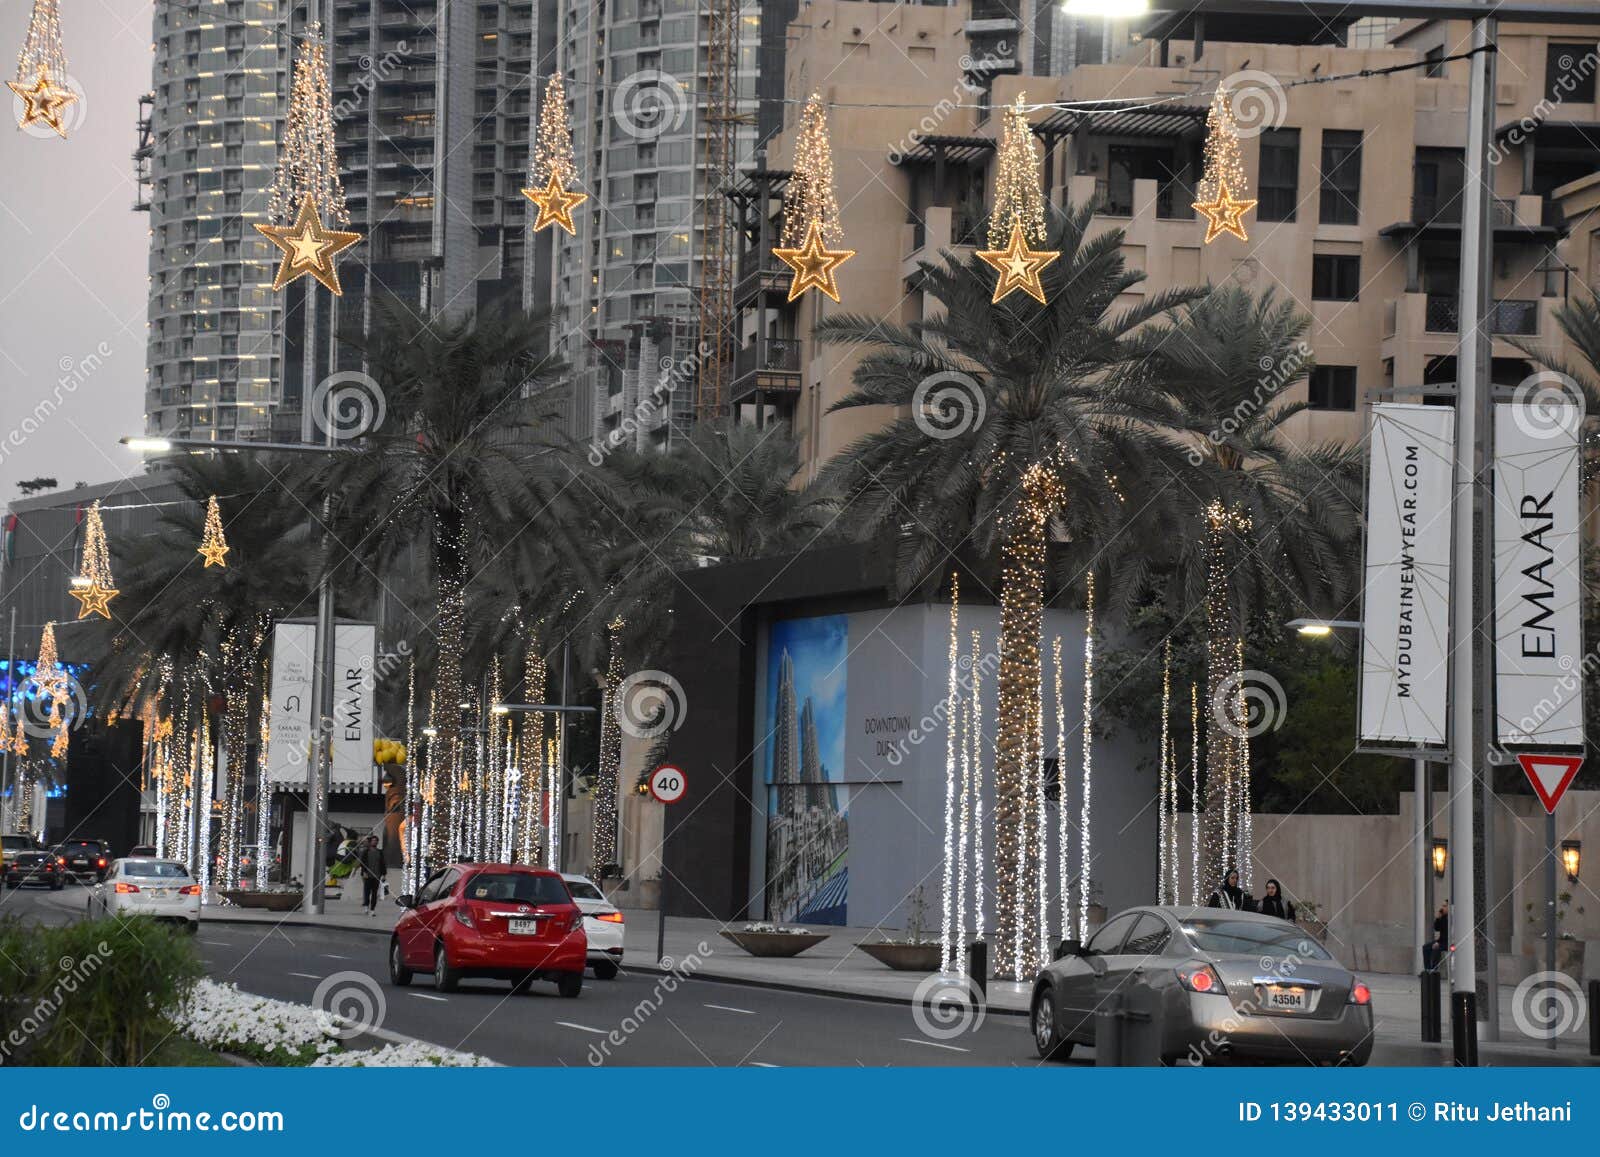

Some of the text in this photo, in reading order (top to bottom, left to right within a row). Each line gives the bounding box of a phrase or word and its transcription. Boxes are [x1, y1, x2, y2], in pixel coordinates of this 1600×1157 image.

[1397, 446, 1419, 698] MYDUBAINEWYEAR.COM
[1520, 490, 1556, 658] EMAAR
[345, 667, 362, 741] EMAAR
[864, 716, 911, 734] DOWNTOWN
[657, 777, 679, 791] 40
[1272, 993, 1301, 1006] 43504
